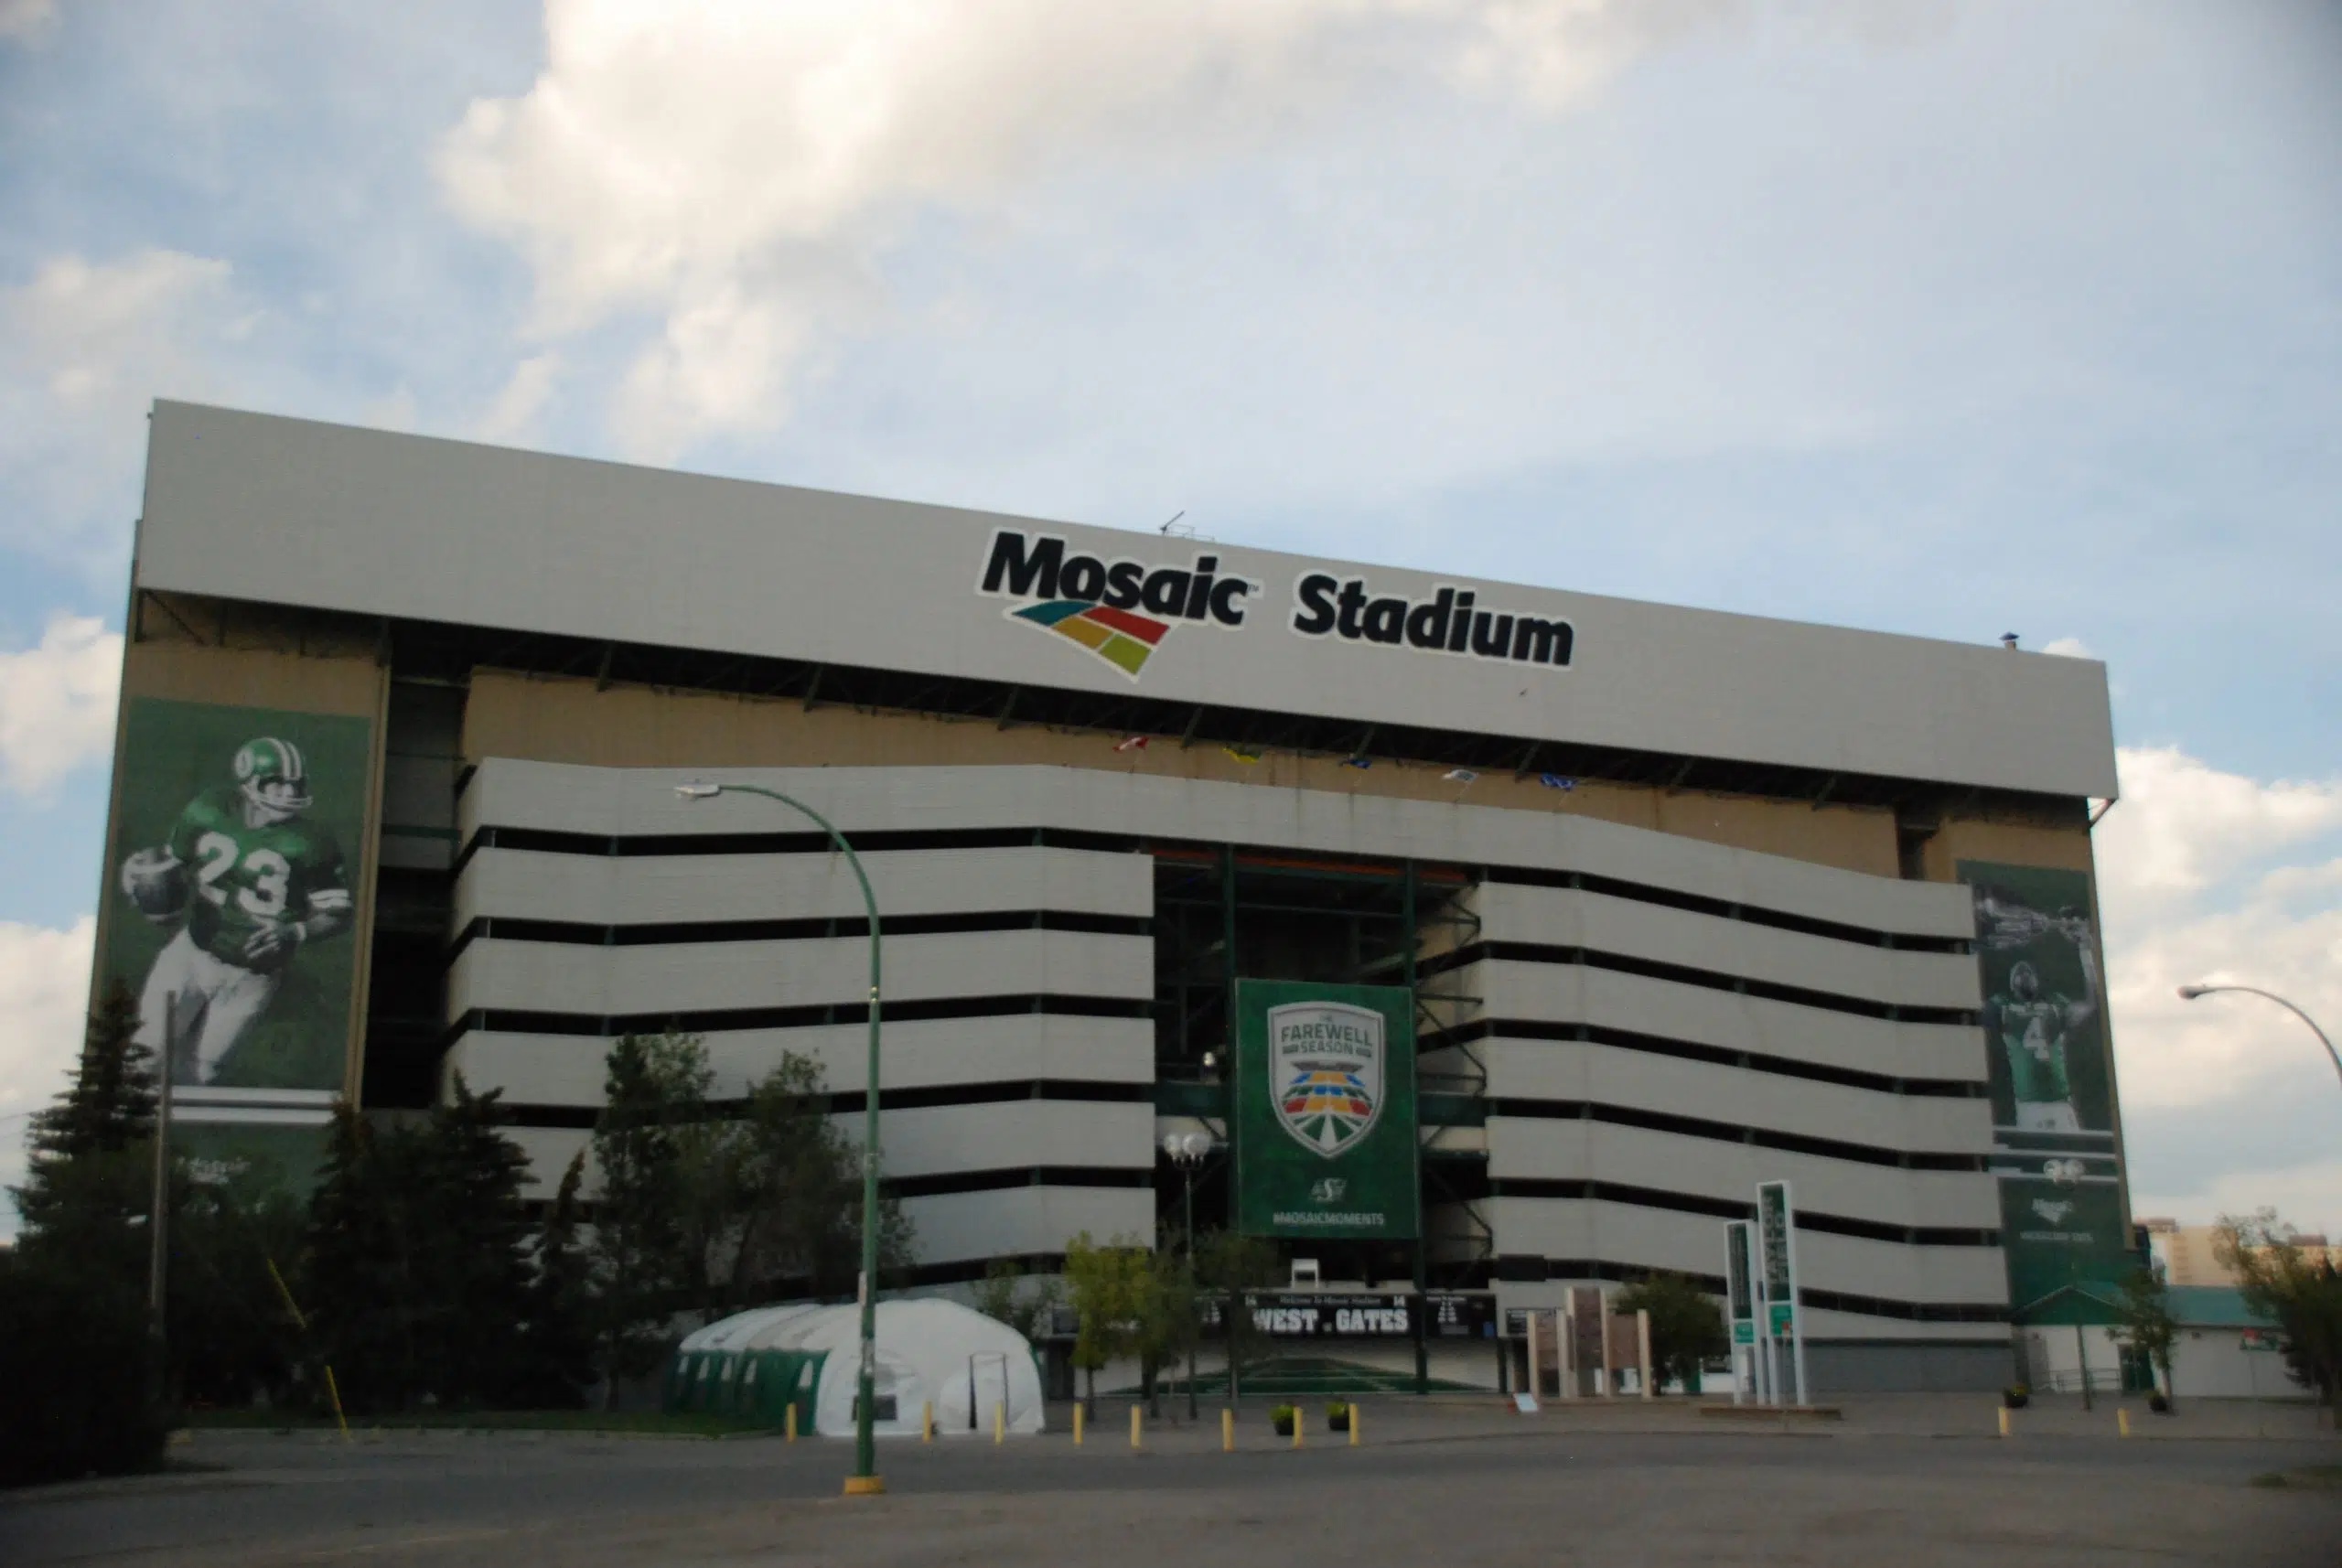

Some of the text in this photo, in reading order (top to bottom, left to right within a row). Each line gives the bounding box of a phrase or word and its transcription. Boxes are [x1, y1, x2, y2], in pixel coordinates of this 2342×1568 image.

[982, 531, 1250, 626] Mosaic
[1293, 573, 1574, 667] Stadium
[196, 831, 291, 916] 23
[1281, 1023, 1372, 1047] FAREWELL
[1297, 1040, 1354, 1055] SEASON
[1273, 1211, 1384, 1226] #MOSAICMOMENTS
[1252, 1308, 1318, 1333] WEST
[1335, 1308, 1409, 1333] GATES
